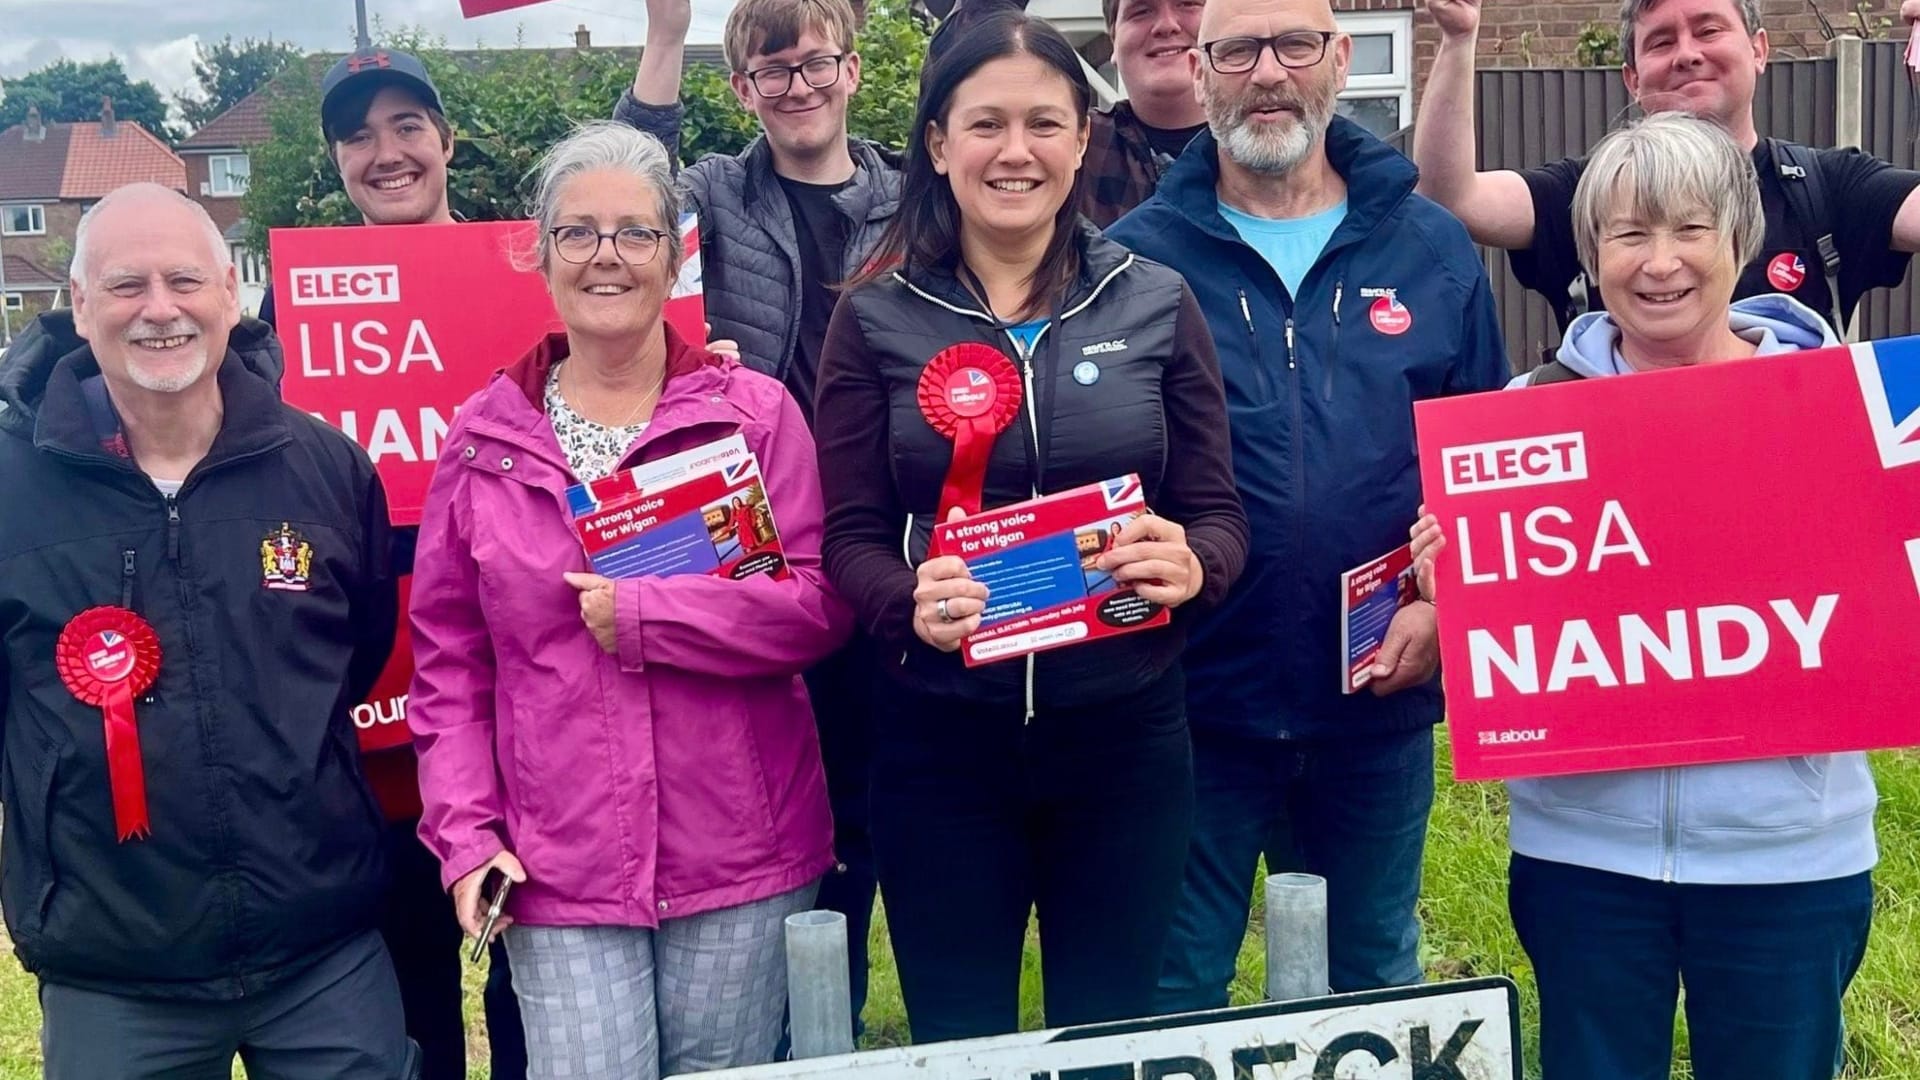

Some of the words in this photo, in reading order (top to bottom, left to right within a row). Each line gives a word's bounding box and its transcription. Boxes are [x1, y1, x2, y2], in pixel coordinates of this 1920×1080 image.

[296, 272, 393, 298] ELECT
[299, 319, 444, 378] LISA
[1450, 440, 1578, 485] ELECT
[584, 521, 594, 532] A
[595, 507, 634, 525] strong
[633, 498, 665, 515] voice
[601, 526, 618, 541] for
[618, 516, 657, 534] Wigan
[944, 530, 954, 541] A
[956, 519, 999, 538] strong
[1000, 512, 1036, 529] voice
[961, 538, 981, 552] for
[981, 530, 1025, 550] Wigan
[1456, 500, 1651, 585] LISA
[1467, 594, 1840, 698] NANDY
[349, 694, 408, 728] our
[1492, 728, 1548, 744] Labour
